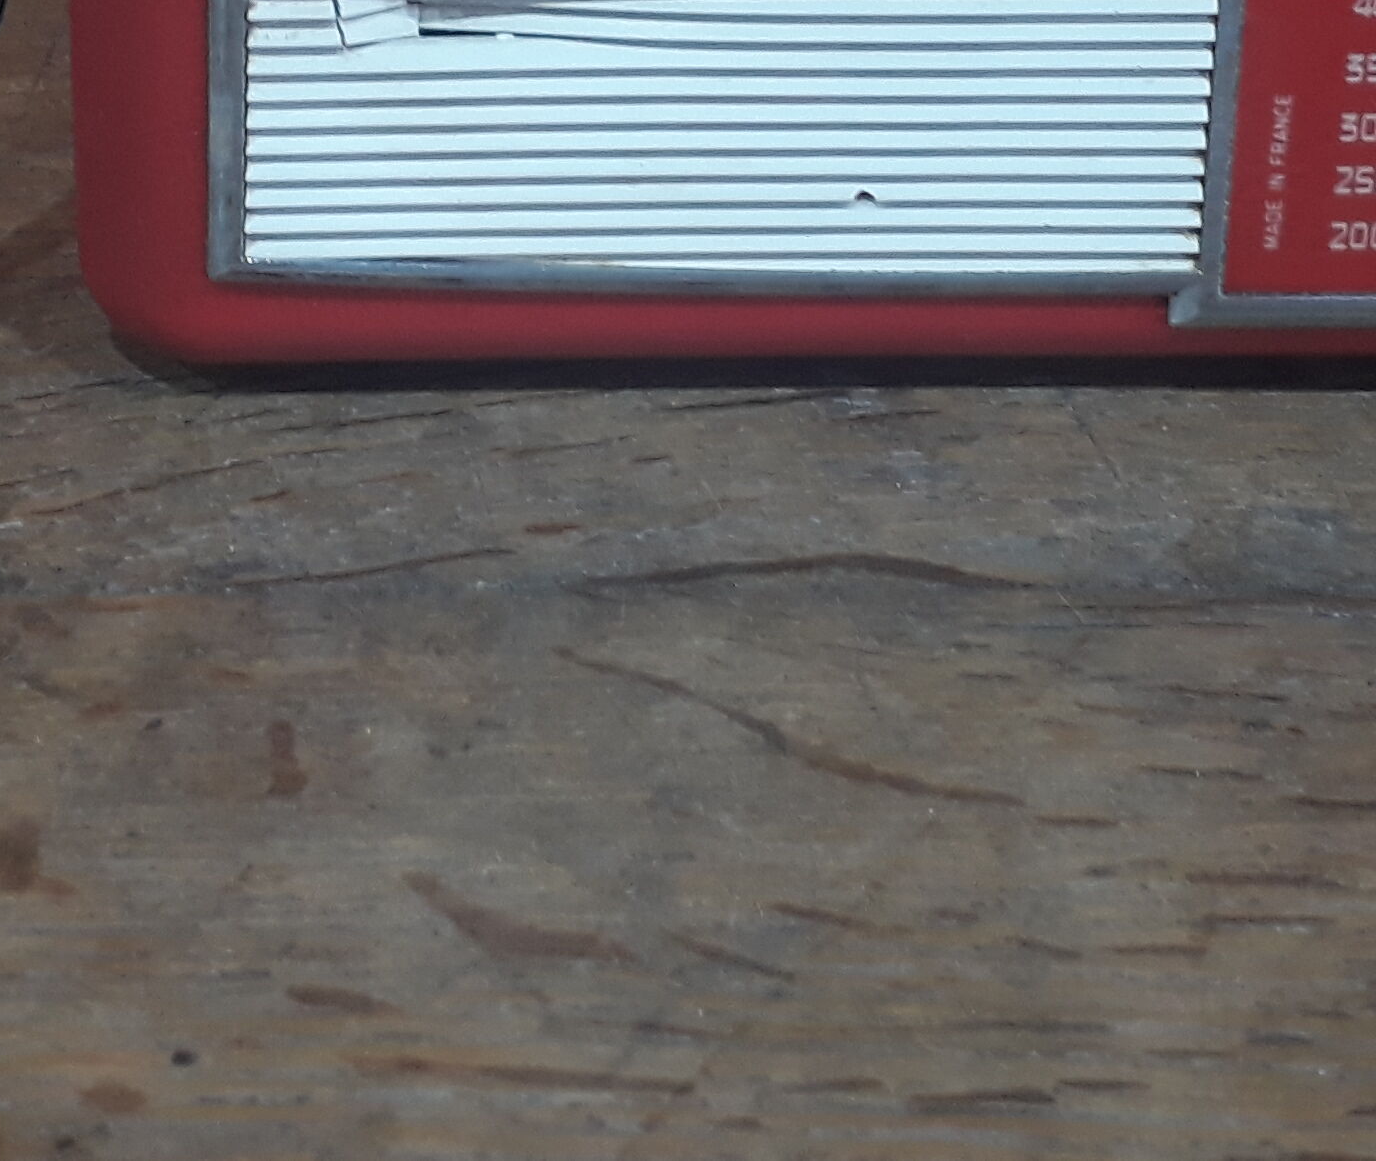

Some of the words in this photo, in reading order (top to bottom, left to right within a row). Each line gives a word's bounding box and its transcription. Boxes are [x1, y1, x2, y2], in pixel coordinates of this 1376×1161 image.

[1268, 94, 1295, 167] FRANCE
[1268, 172, 1287, 189] IN
[1263, 199, 1285, 251] MADE
